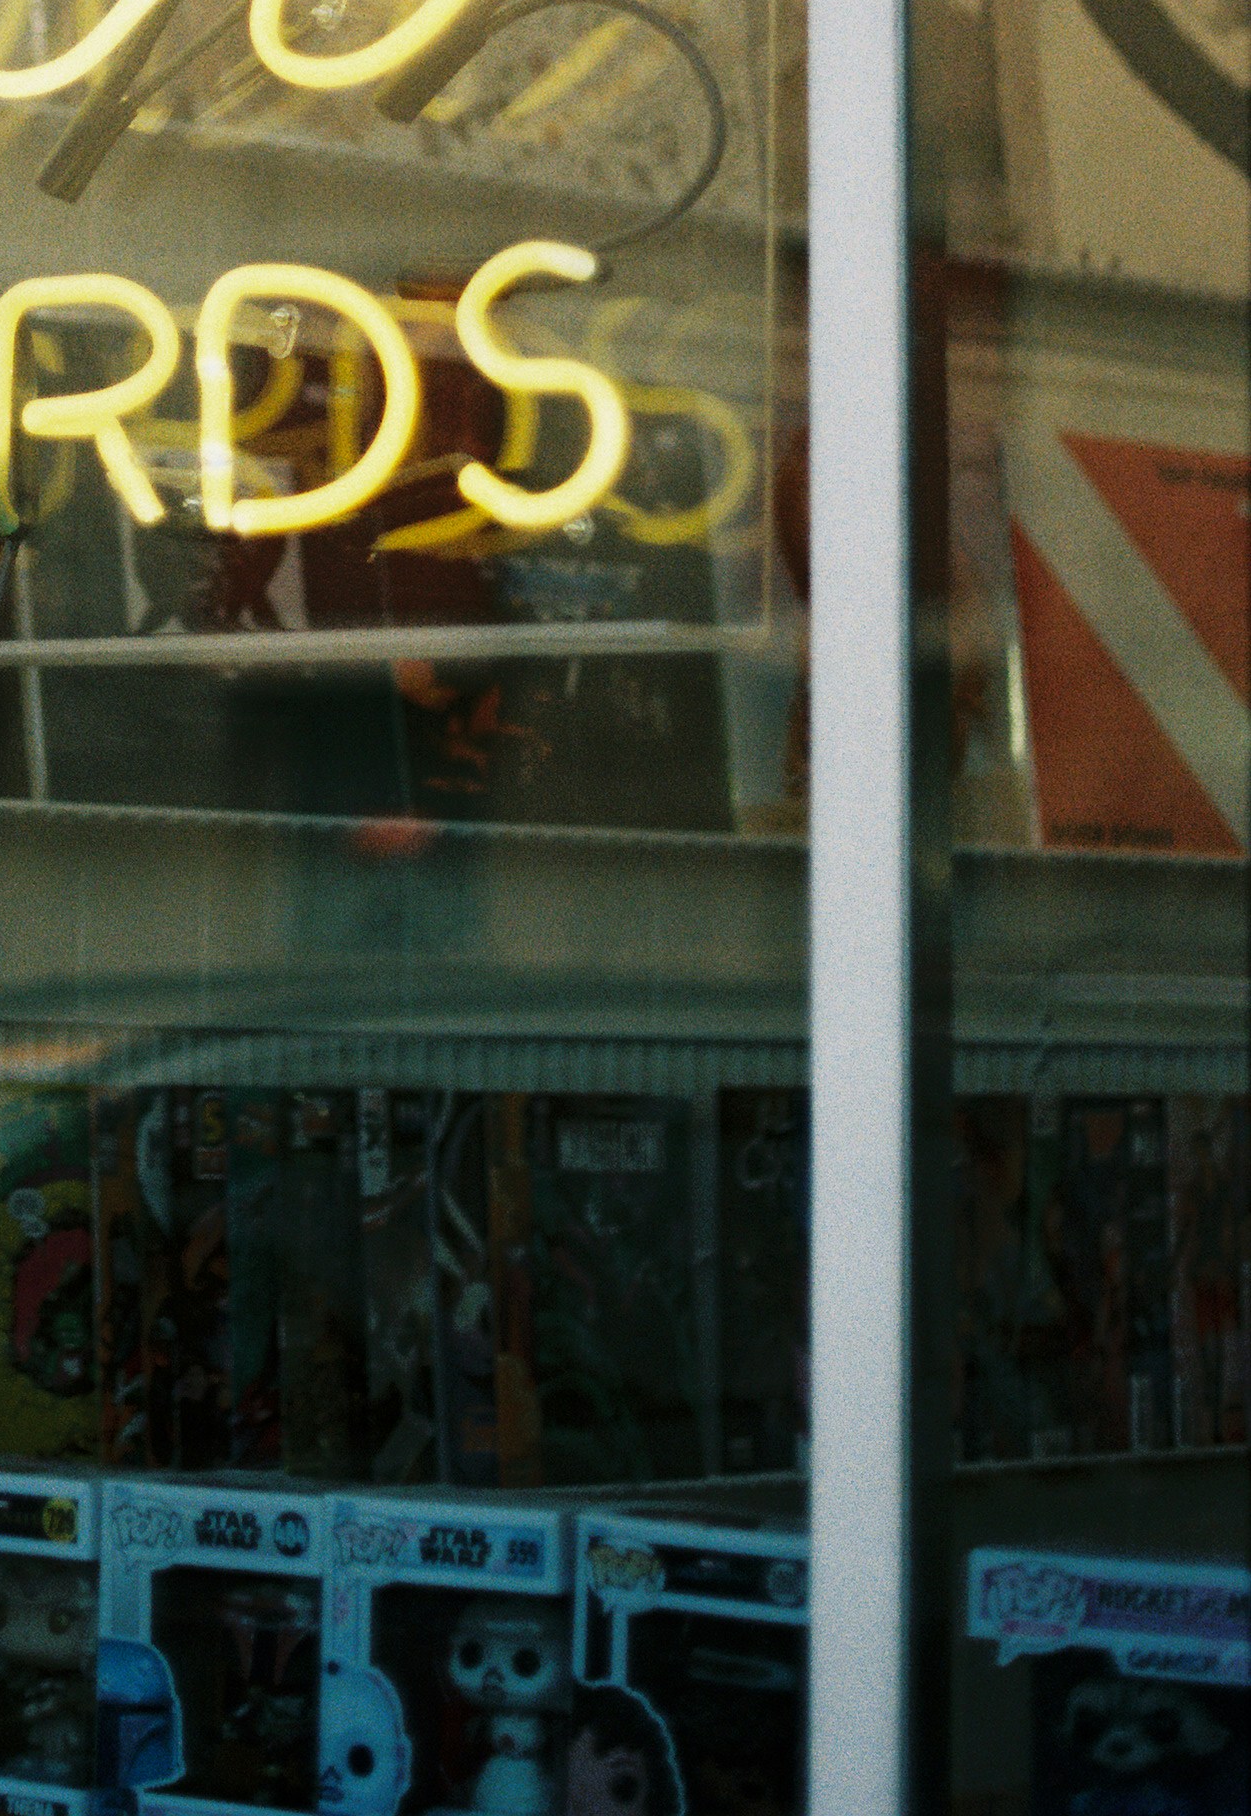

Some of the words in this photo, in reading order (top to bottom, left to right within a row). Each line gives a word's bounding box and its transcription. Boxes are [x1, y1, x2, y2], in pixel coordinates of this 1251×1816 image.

[111, 1503, 184, 1550] POP!
[194, 1508, 262, 1531] STAR
[195, 1528, 262, 1550] WARS
[333, 1520, 409, 1567] POP!
[419, 1525, 491, 1548] STAR
[419, 1545, 492, 1569] WARS
